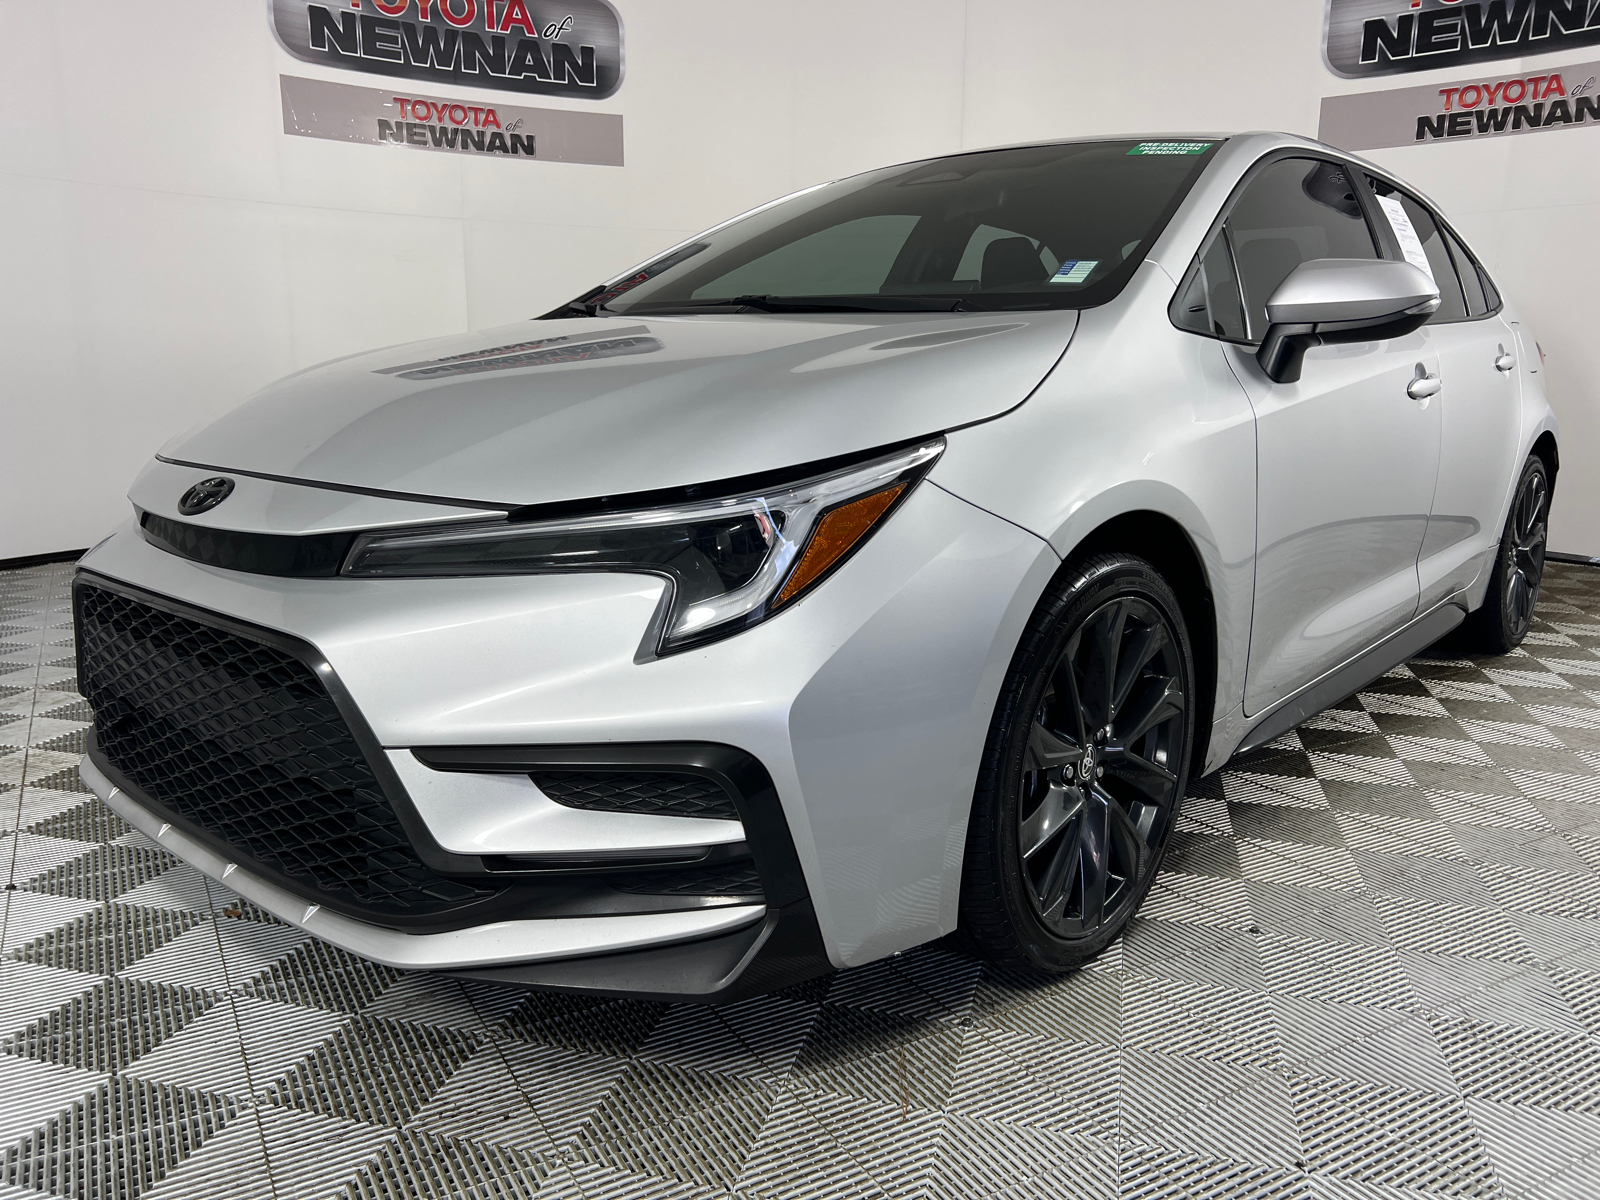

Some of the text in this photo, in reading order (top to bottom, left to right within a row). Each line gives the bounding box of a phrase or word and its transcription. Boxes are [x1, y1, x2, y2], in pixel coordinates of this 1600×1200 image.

[350, 0, 573, 40] YOTA of
[1359, 0, 1600, 64] NEWN
[308, 3, 597, 87] NEWNAN
[1438, 73, 1596, 111] TOYOTA of
[393, 96, 523, 132] TOYOTA of
[1415, 95, 1600, 142] NEWNAN
[378, 118, 536, 157] NEWNAN
